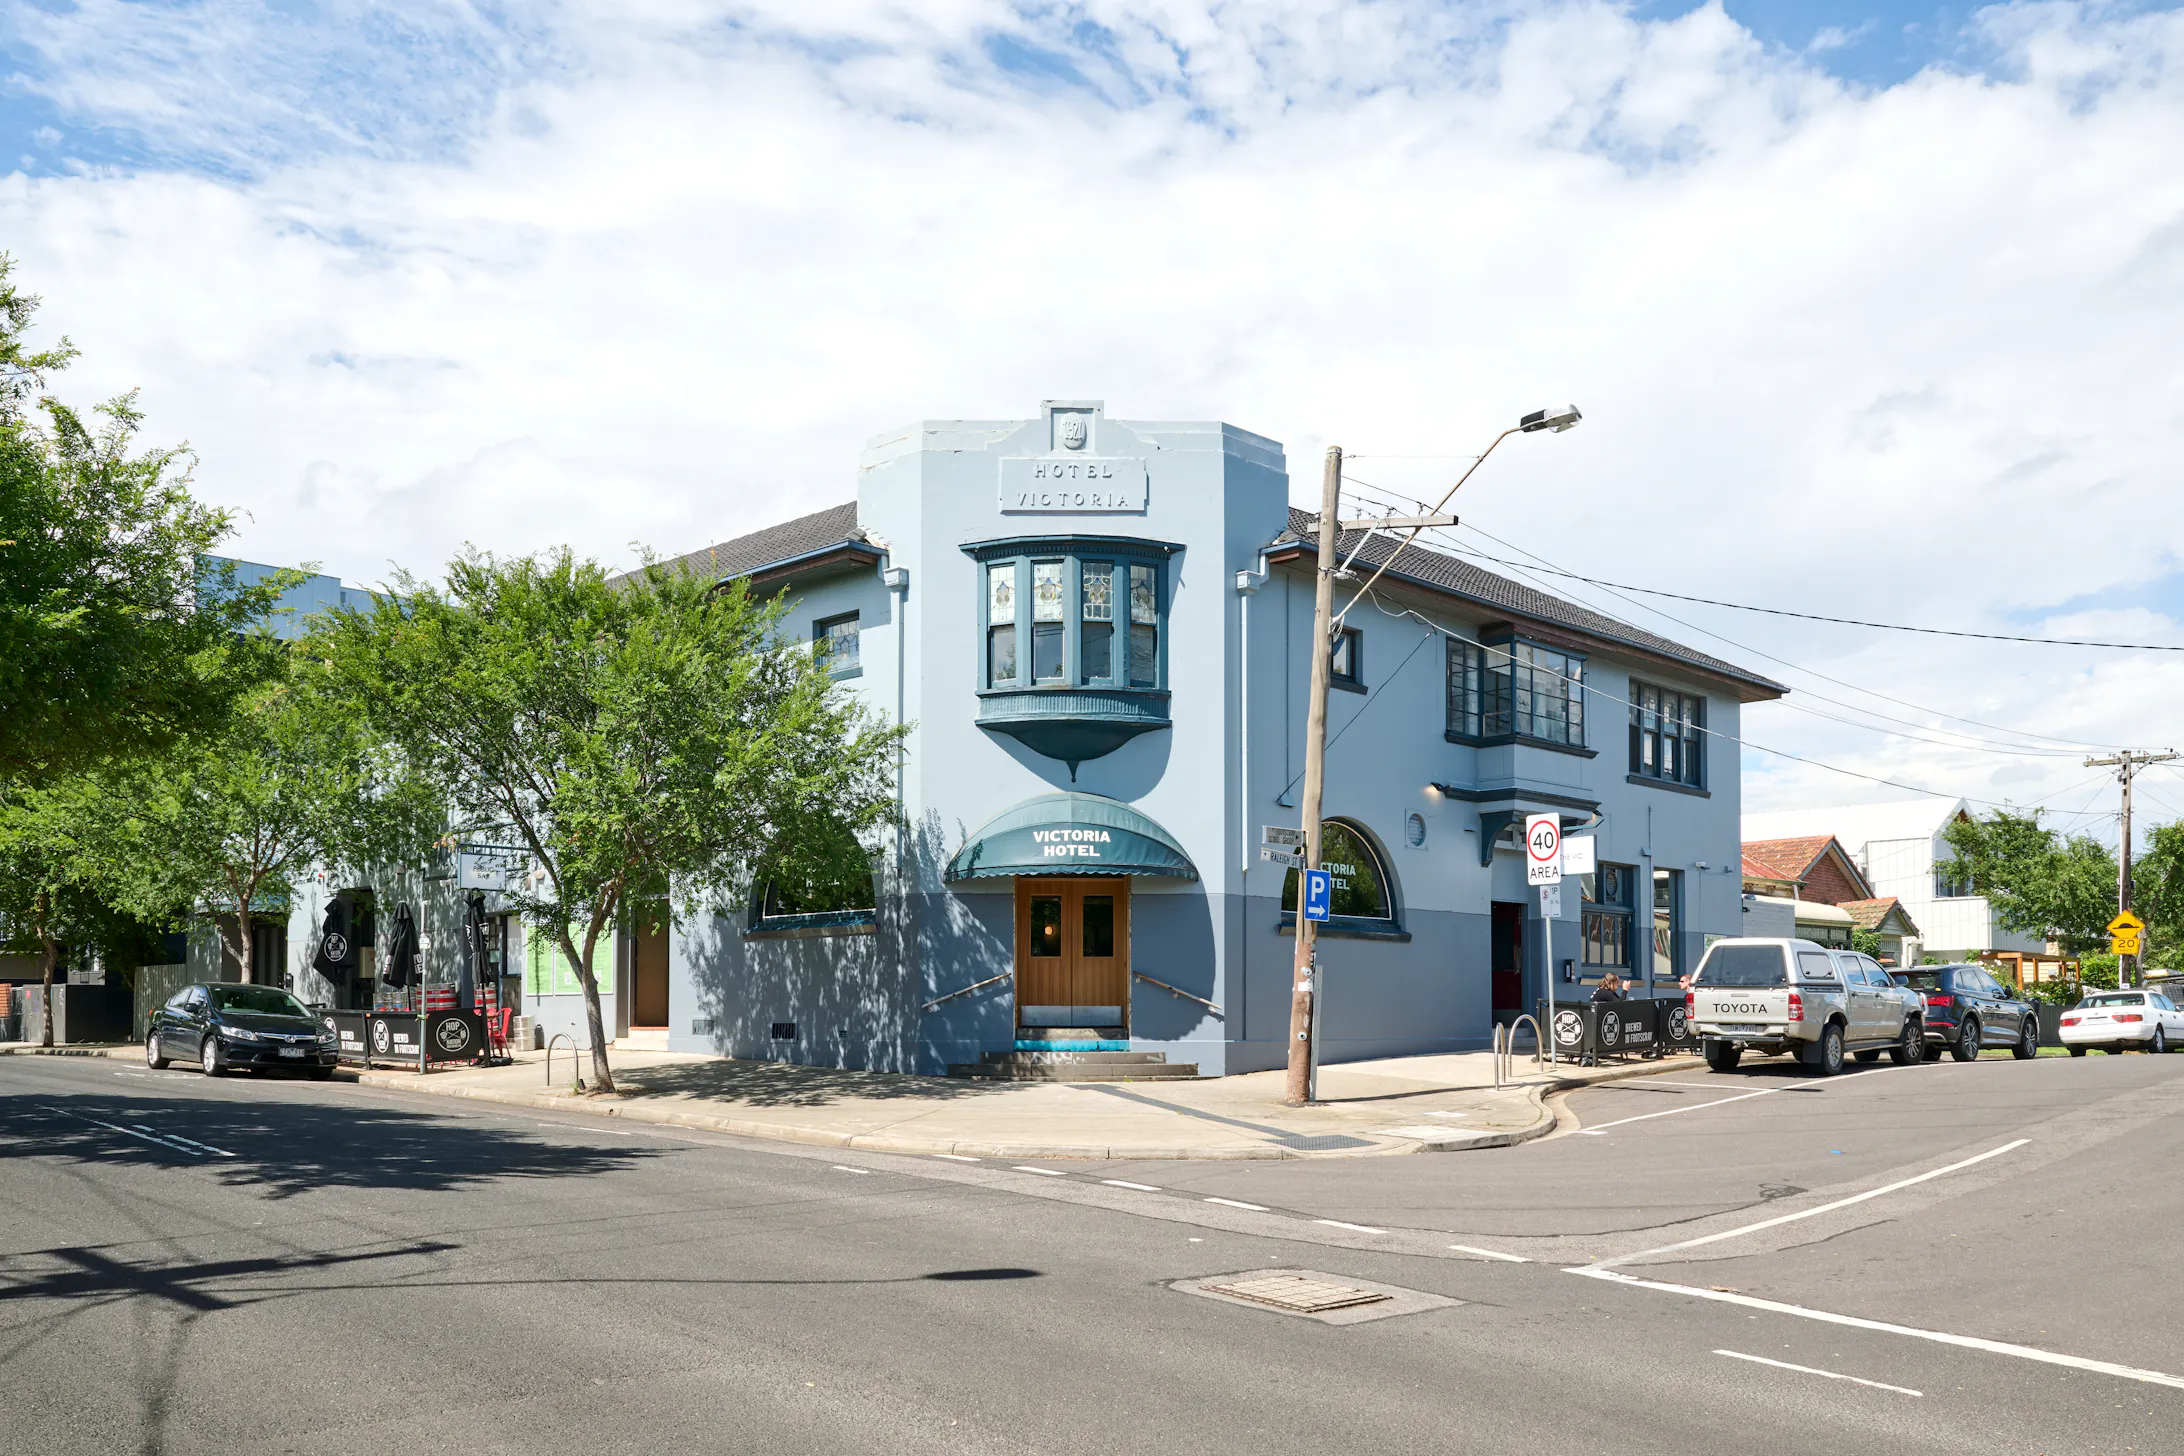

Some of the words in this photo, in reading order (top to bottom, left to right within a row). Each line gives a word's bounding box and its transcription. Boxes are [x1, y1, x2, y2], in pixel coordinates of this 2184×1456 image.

[1035, 464, 1113, 479] HOTEL
[1018, 492, 1128, 507] VICTORIA
[1033, 829, 1111, 843] VICTORIA
[1533, 831, 1554, 850] 40
[1044, 844, 1101, 857] HOTEL
[1271, 852, 1290, 865] RALEIGH
[1291, 857, 1298, 867] ST
[1320, 862, 1356, 876] CTORIA
[1530, 866, 1559, 879] AREA
[1311, 876, 1325, 902] P
[1330, 877, 1350, 890] TEL
[2118, 939, 2135, 948] 20
[1713, 1003, 1768, 1013] TOYOTA
[1561, 1014, 1576, 1024] HOP
[446, 1021, 460, 1031] HOP
